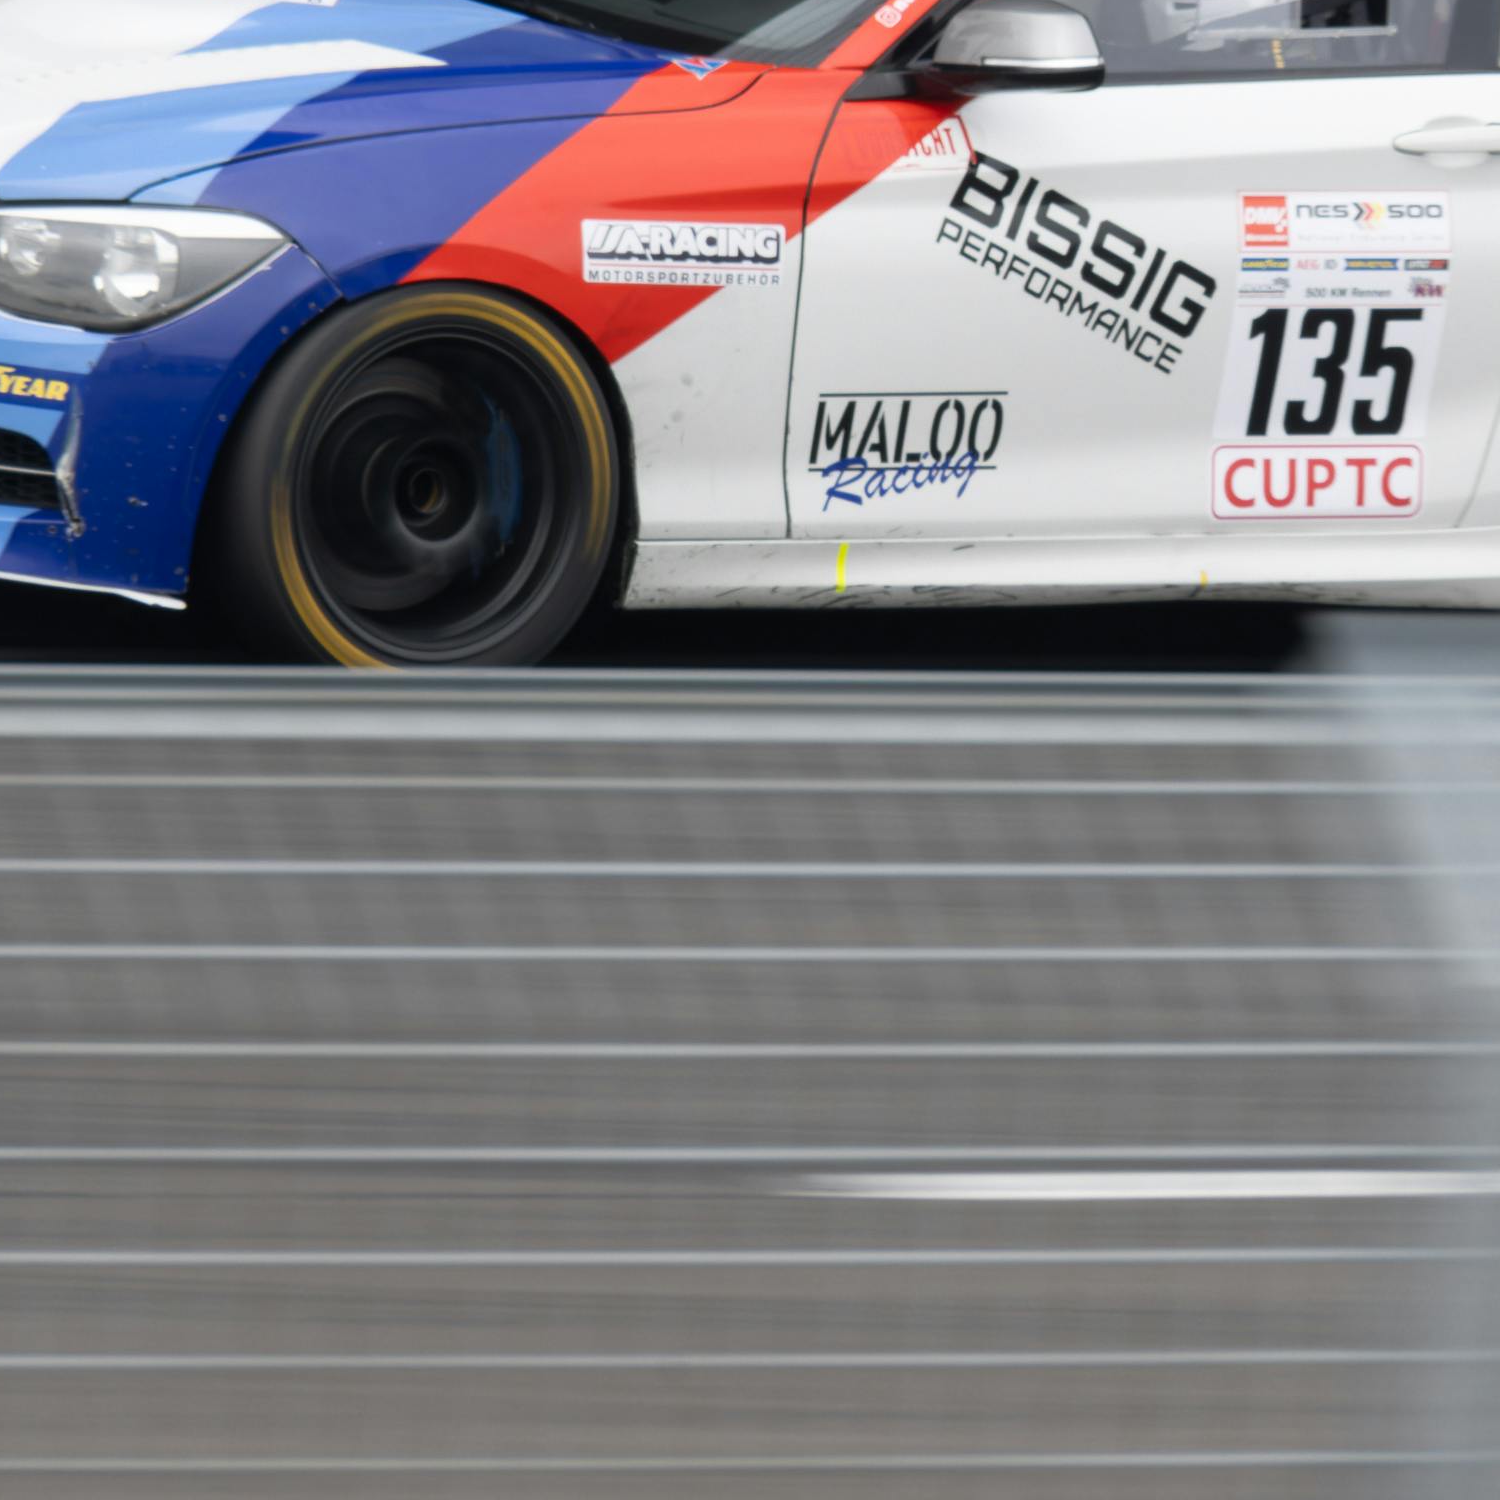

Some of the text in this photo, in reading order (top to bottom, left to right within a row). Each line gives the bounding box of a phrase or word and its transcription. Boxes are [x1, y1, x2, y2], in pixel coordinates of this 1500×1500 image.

[950, 150, 1217, 339] BISSIG
[1387, 204, 1444, 219] 500
[936, 217, 1183, 375] PERFORMANCE
[1245, 308, 1424, 437] 135
[809, 398, 1004, 464] MALOO
[821, 450, 980, 512] Racing
